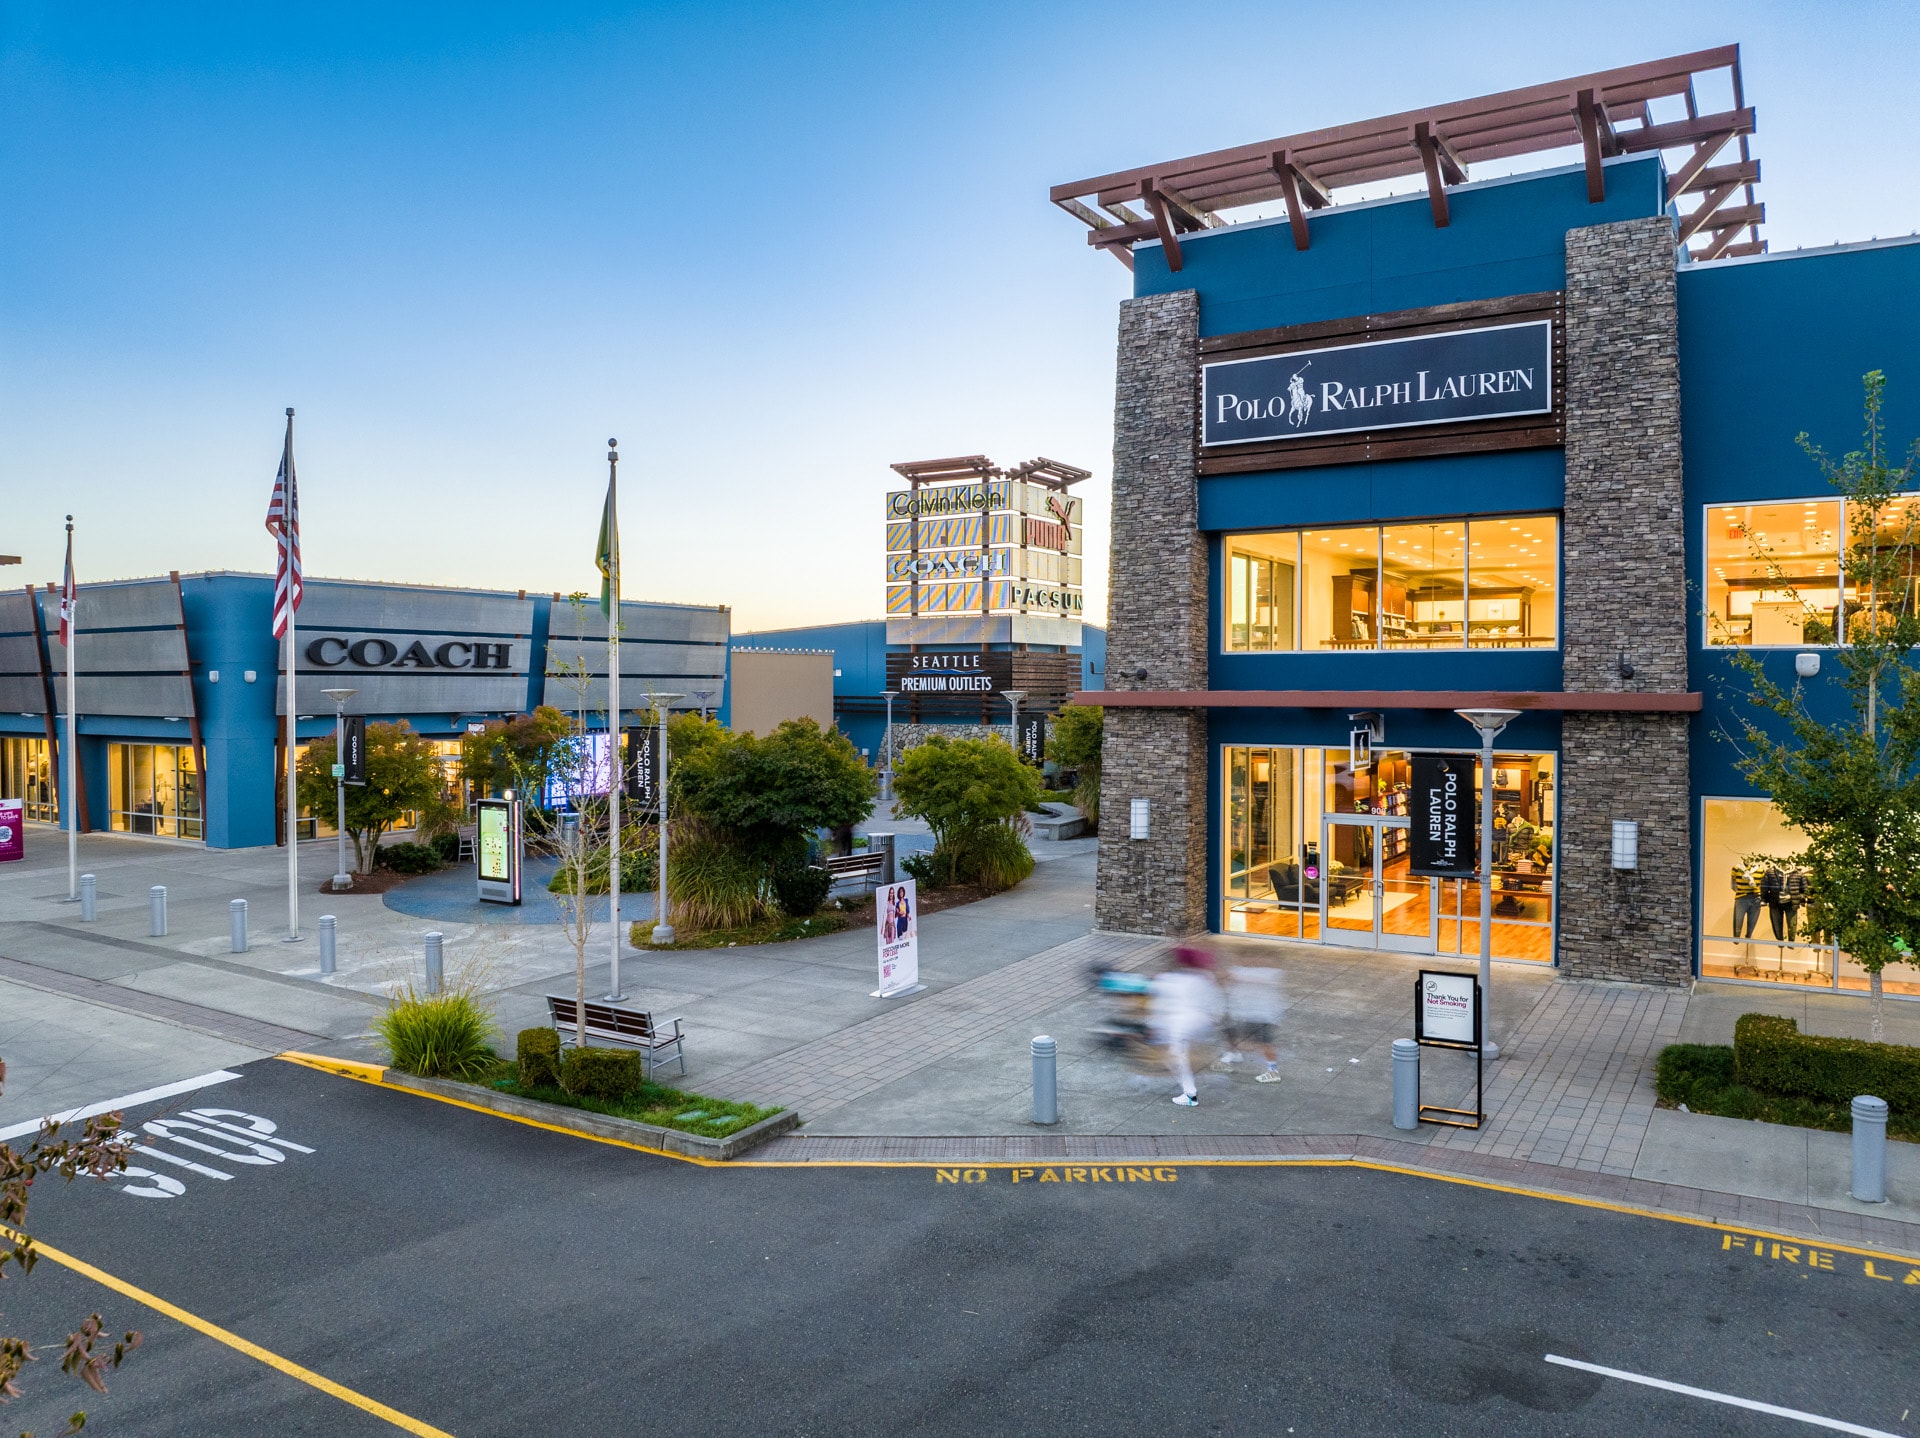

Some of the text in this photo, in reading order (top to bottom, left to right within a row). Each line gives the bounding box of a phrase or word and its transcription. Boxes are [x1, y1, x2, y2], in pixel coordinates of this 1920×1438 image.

[1216, 369, 1534, 423] POLO RALPH LAUREN
[893, 486, 1002, 515] Calvin Klein
[1024, 518, 1066, 550] PUMA
[889, 554, 1005, 576] COACH
[1012, 587, 1083, 610] PACSUN
[306, 637, 513, 668] COACH
[912, 655, 980, 668] SEATTLE
[901, 676, 992, 691] PREMIUM OUTLETS
[1429, 788, 1441, 841] LAUREN
[1444, 773, 1457, 857] POLO RALPH
[1440, 1000, 1467, 1009] Smoking
[1447, 994, 1459, 1002] You
[54, 1108, 317, 1198] STOP
[936, 1168, 1178, 1183] NO PARKING
[1722, 1234, 1834, 1271] FIRE
